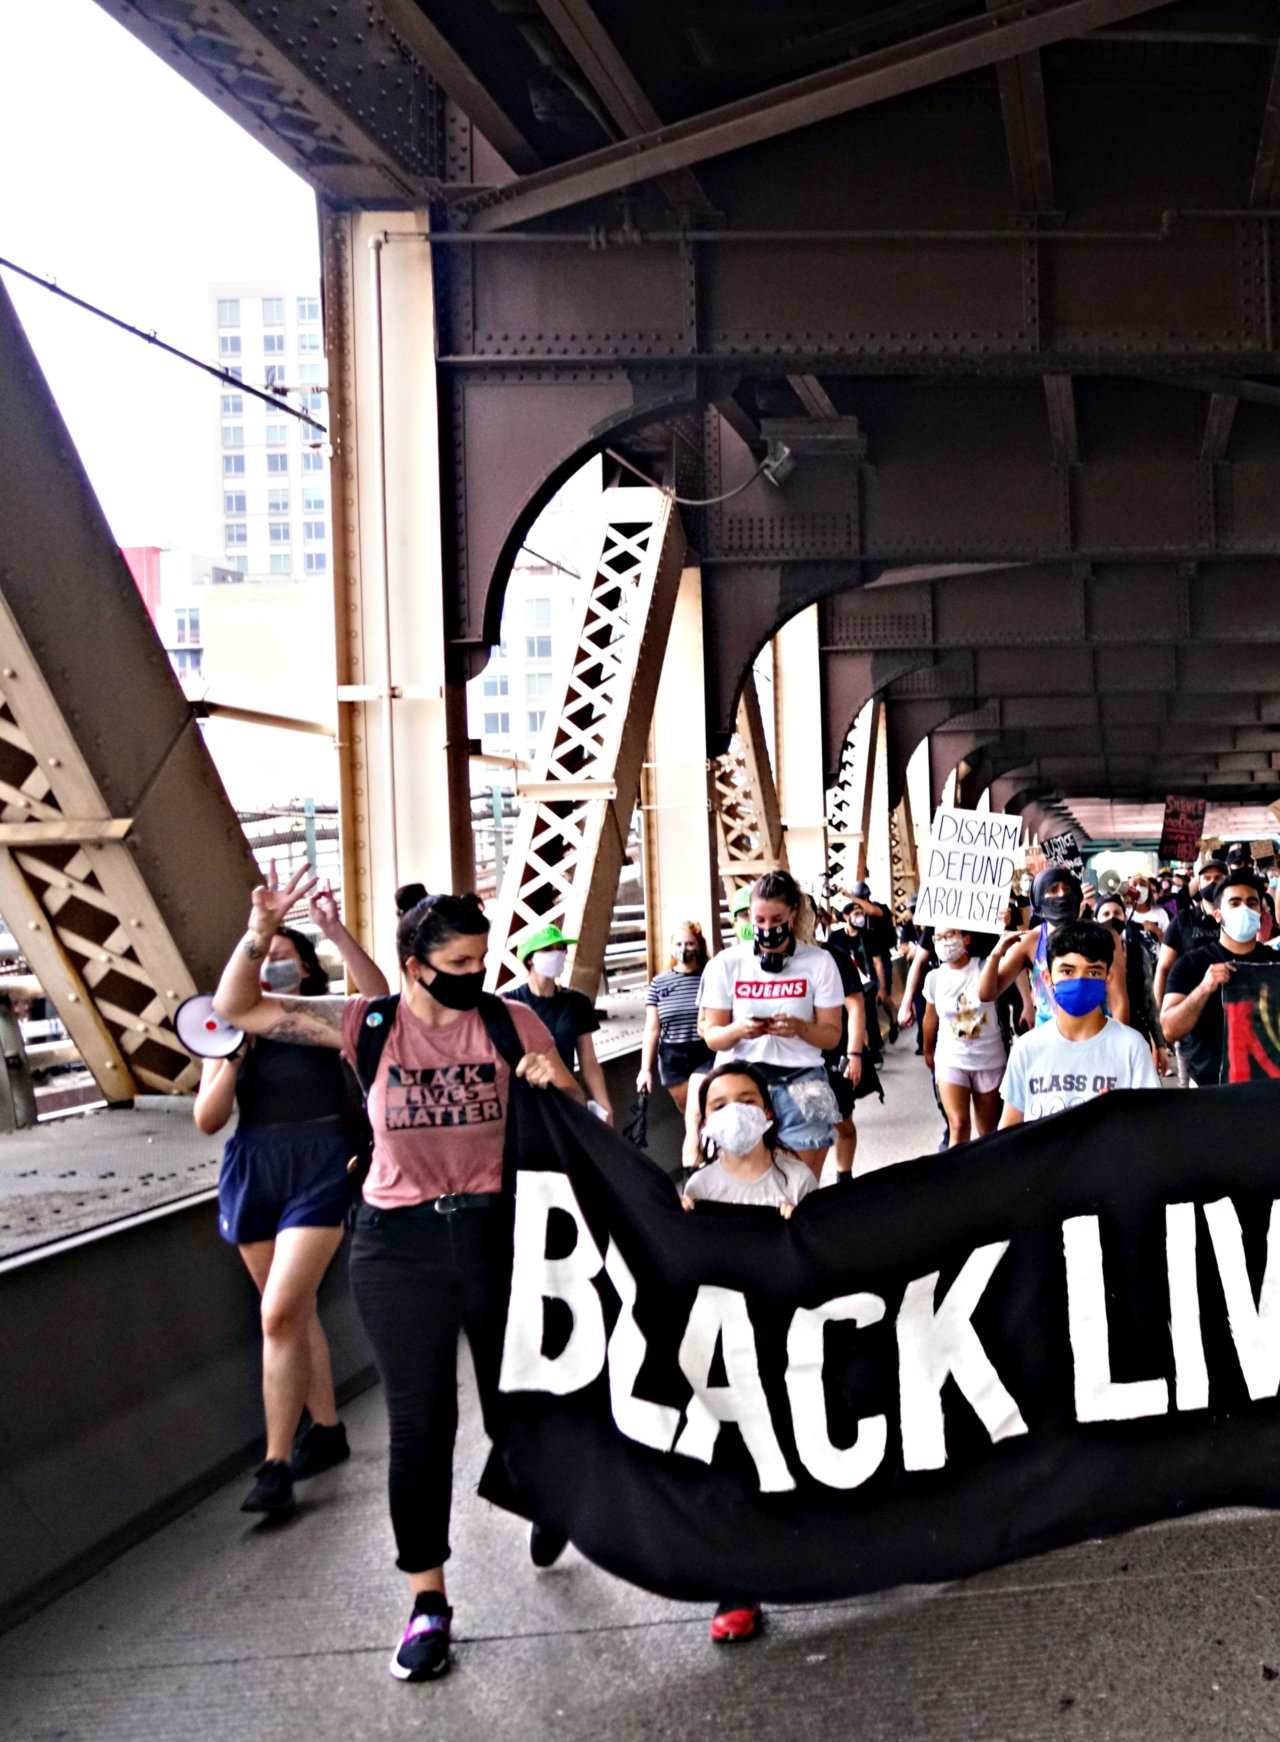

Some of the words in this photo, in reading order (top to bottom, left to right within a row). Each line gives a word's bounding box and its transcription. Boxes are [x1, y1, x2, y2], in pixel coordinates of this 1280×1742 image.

[938, 815, 1018, 851] DISARM
[928, 849, 1015, 888] DEFUND
[918, 886, 1001, 925] ABOLISH
[737, 981, 803, 998] QUEENS
[1029, 1074, 1087, 1095] CLASS
[1092, 1074, 1117, 1093] OF
[387, 1101, 500, 1129] MATTER
[501, 1170, 1028, 1494] BLACK
